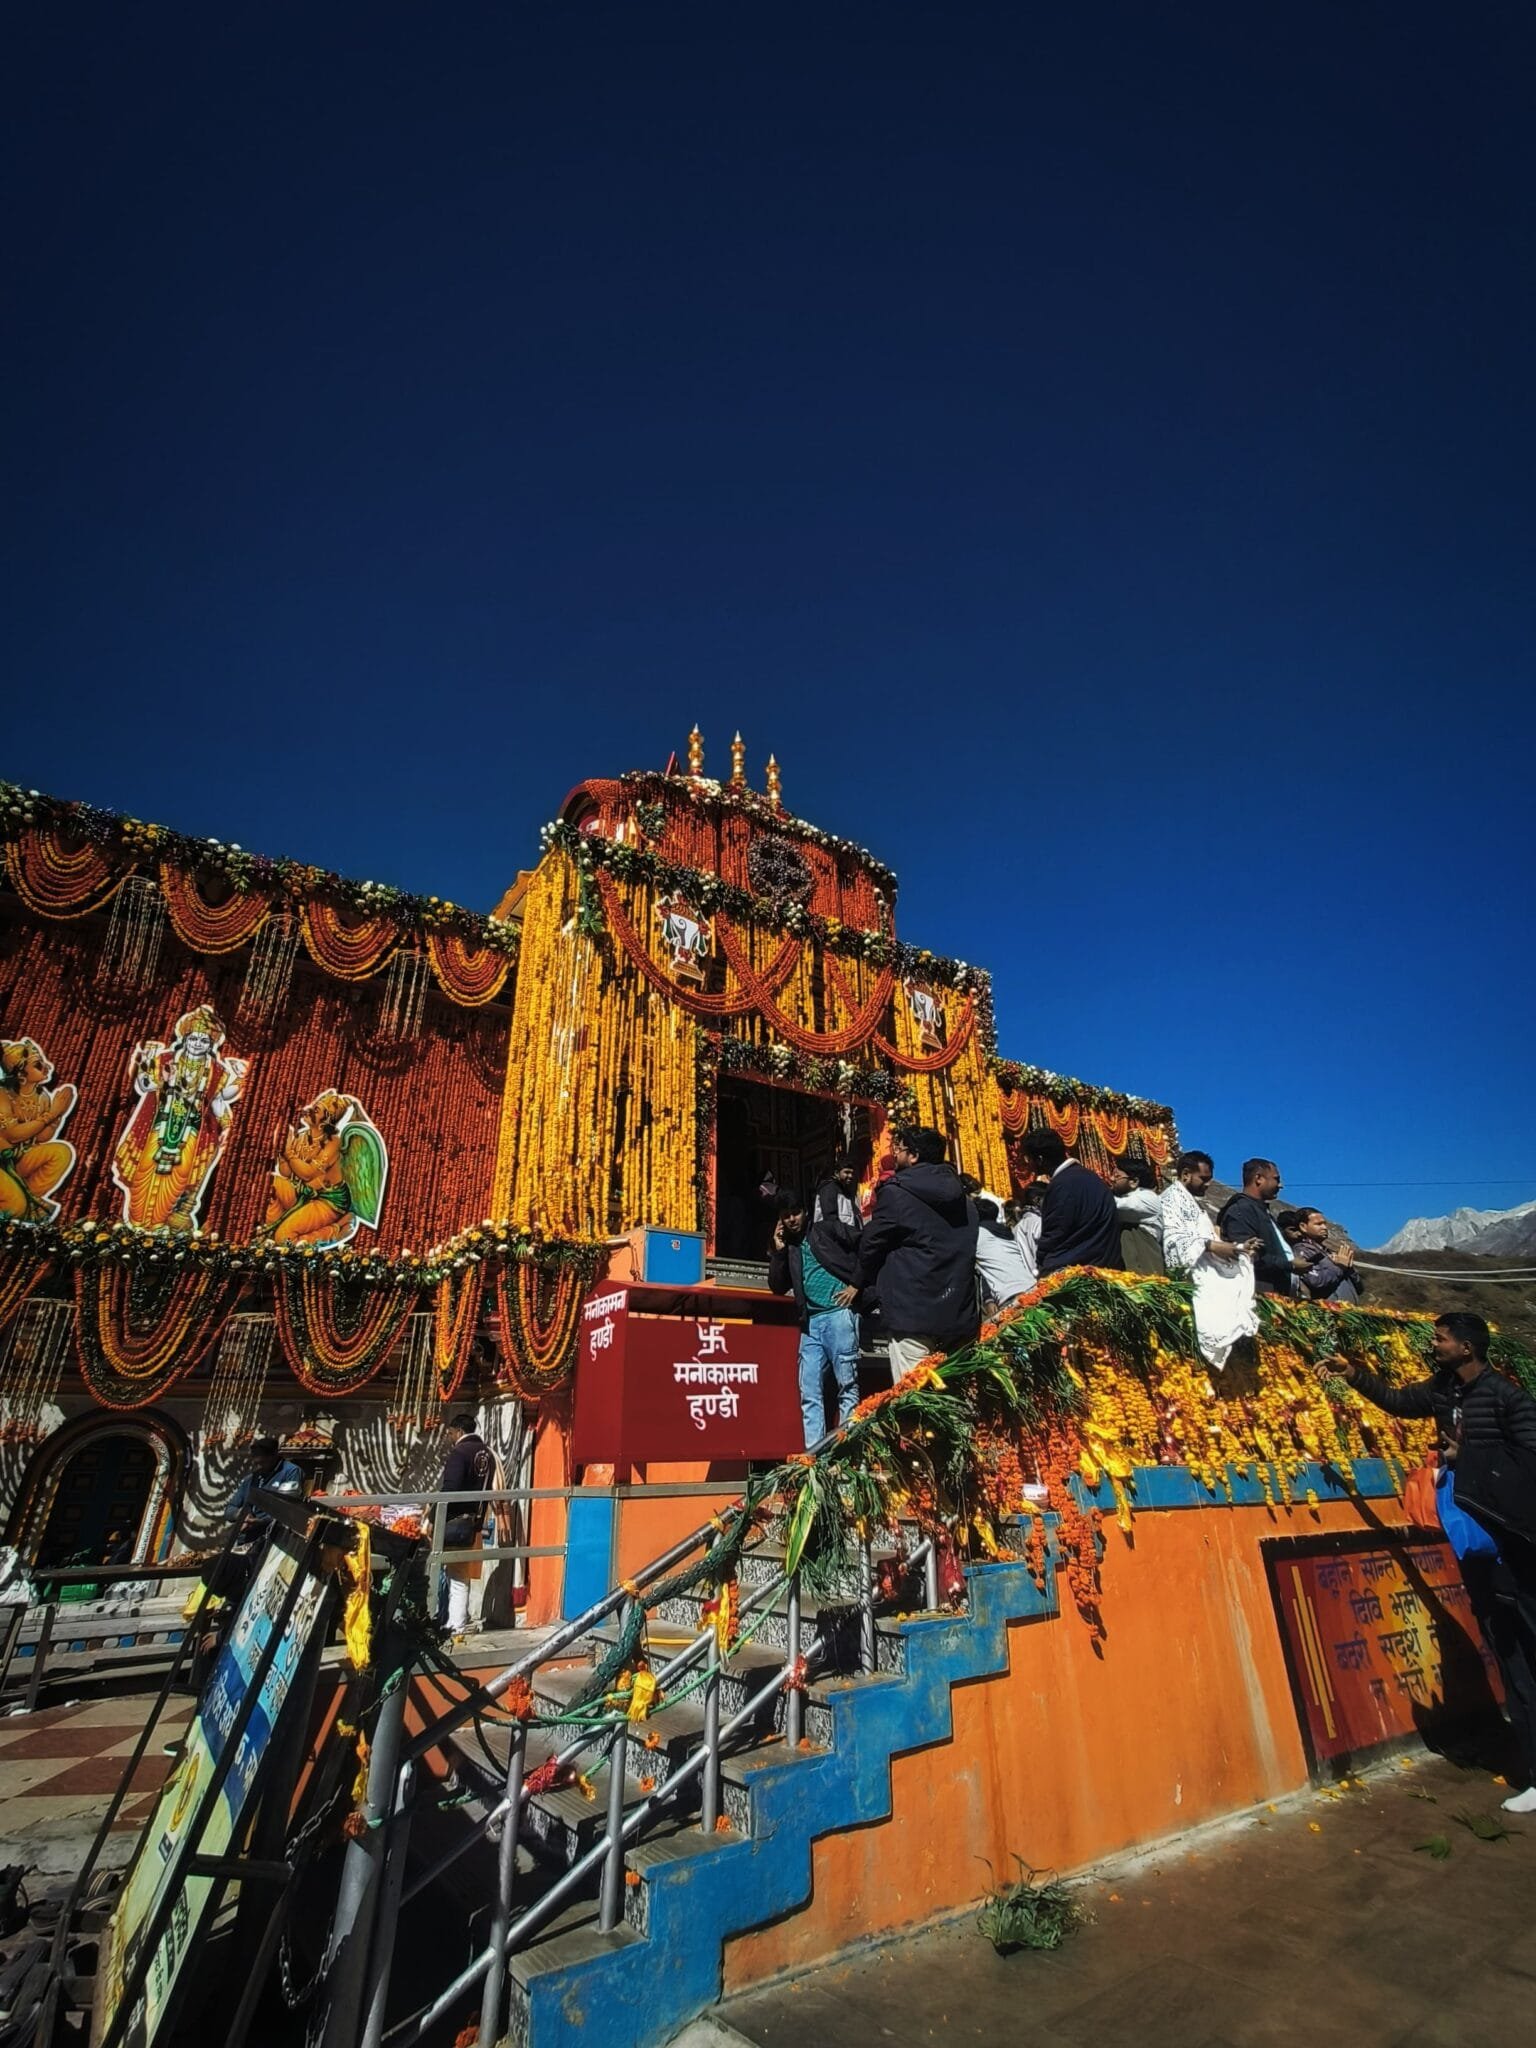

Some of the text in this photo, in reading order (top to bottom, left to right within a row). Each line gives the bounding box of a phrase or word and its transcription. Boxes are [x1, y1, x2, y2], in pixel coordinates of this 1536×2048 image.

[584, 1289, 627, 1321] मनोकामना
[590, 1316, 615, 1362] हुण्डी
[672, 1356, 758, 1385] मनोकामना
[686, 1386, 739, 1431] हुण्डी
